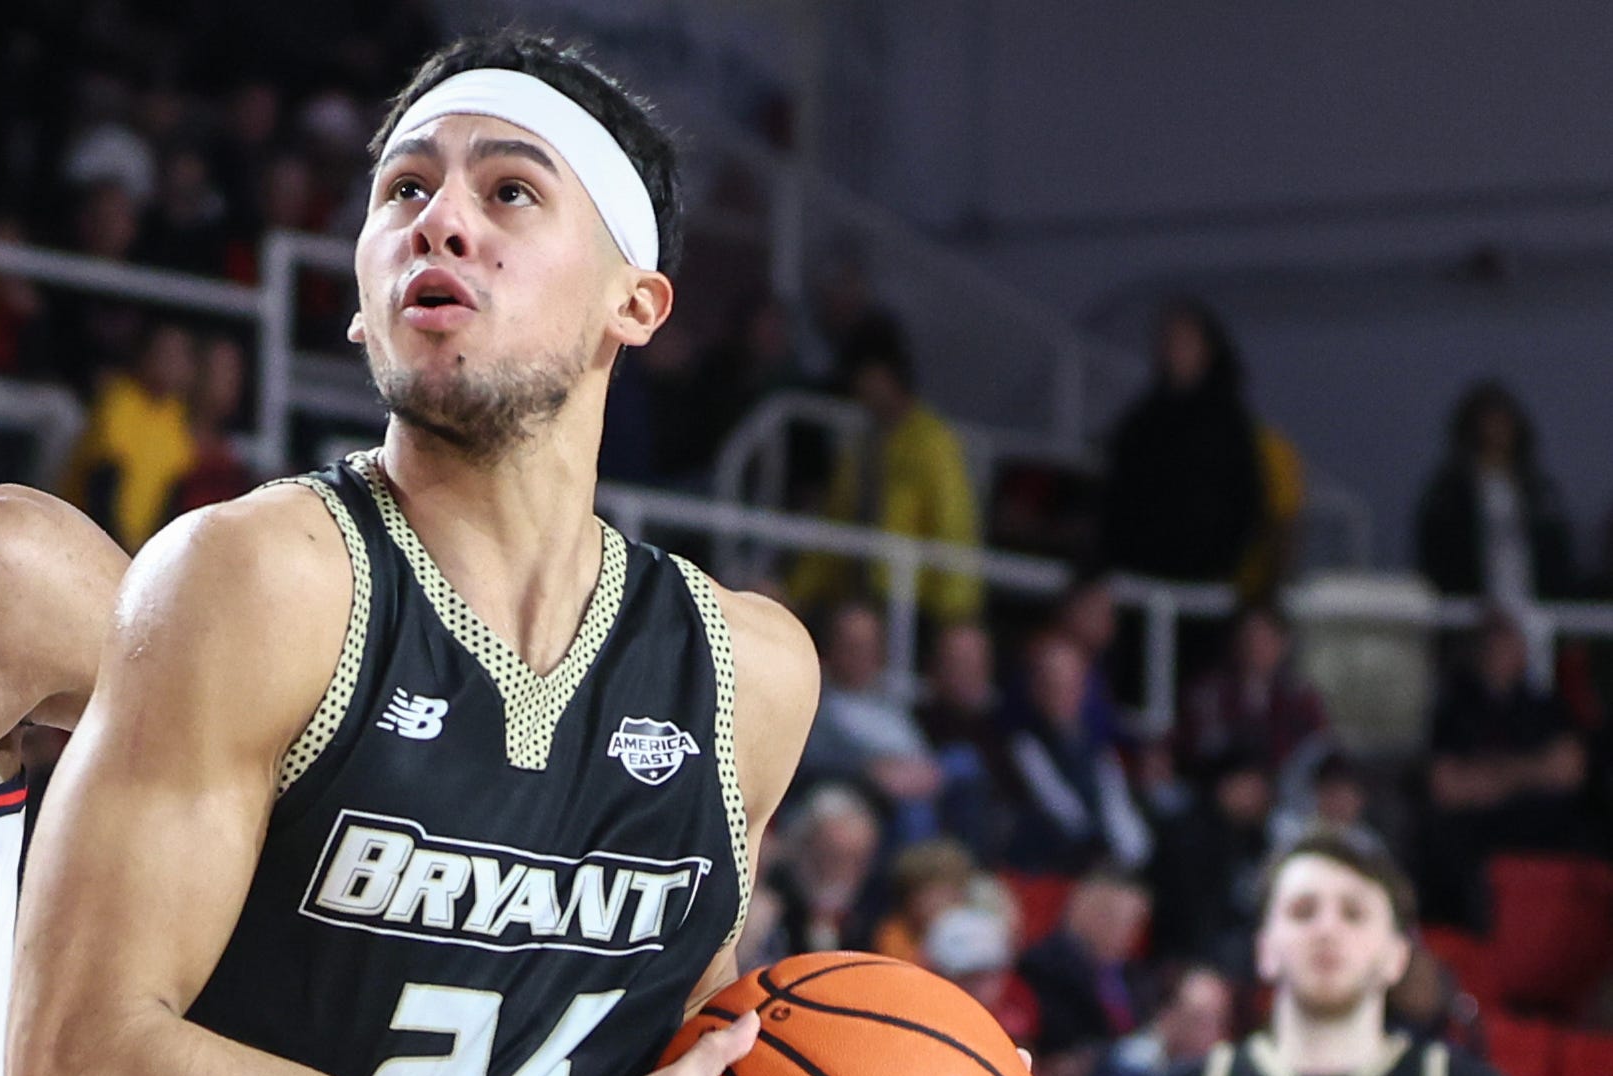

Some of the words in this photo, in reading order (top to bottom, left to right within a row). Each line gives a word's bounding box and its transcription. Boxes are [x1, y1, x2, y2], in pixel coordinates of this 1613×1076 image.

[612, 734, 691, 752] AMERICA
[628, 751, 675, 766] EAST
[315, 824, 691, 944] BRYANT
